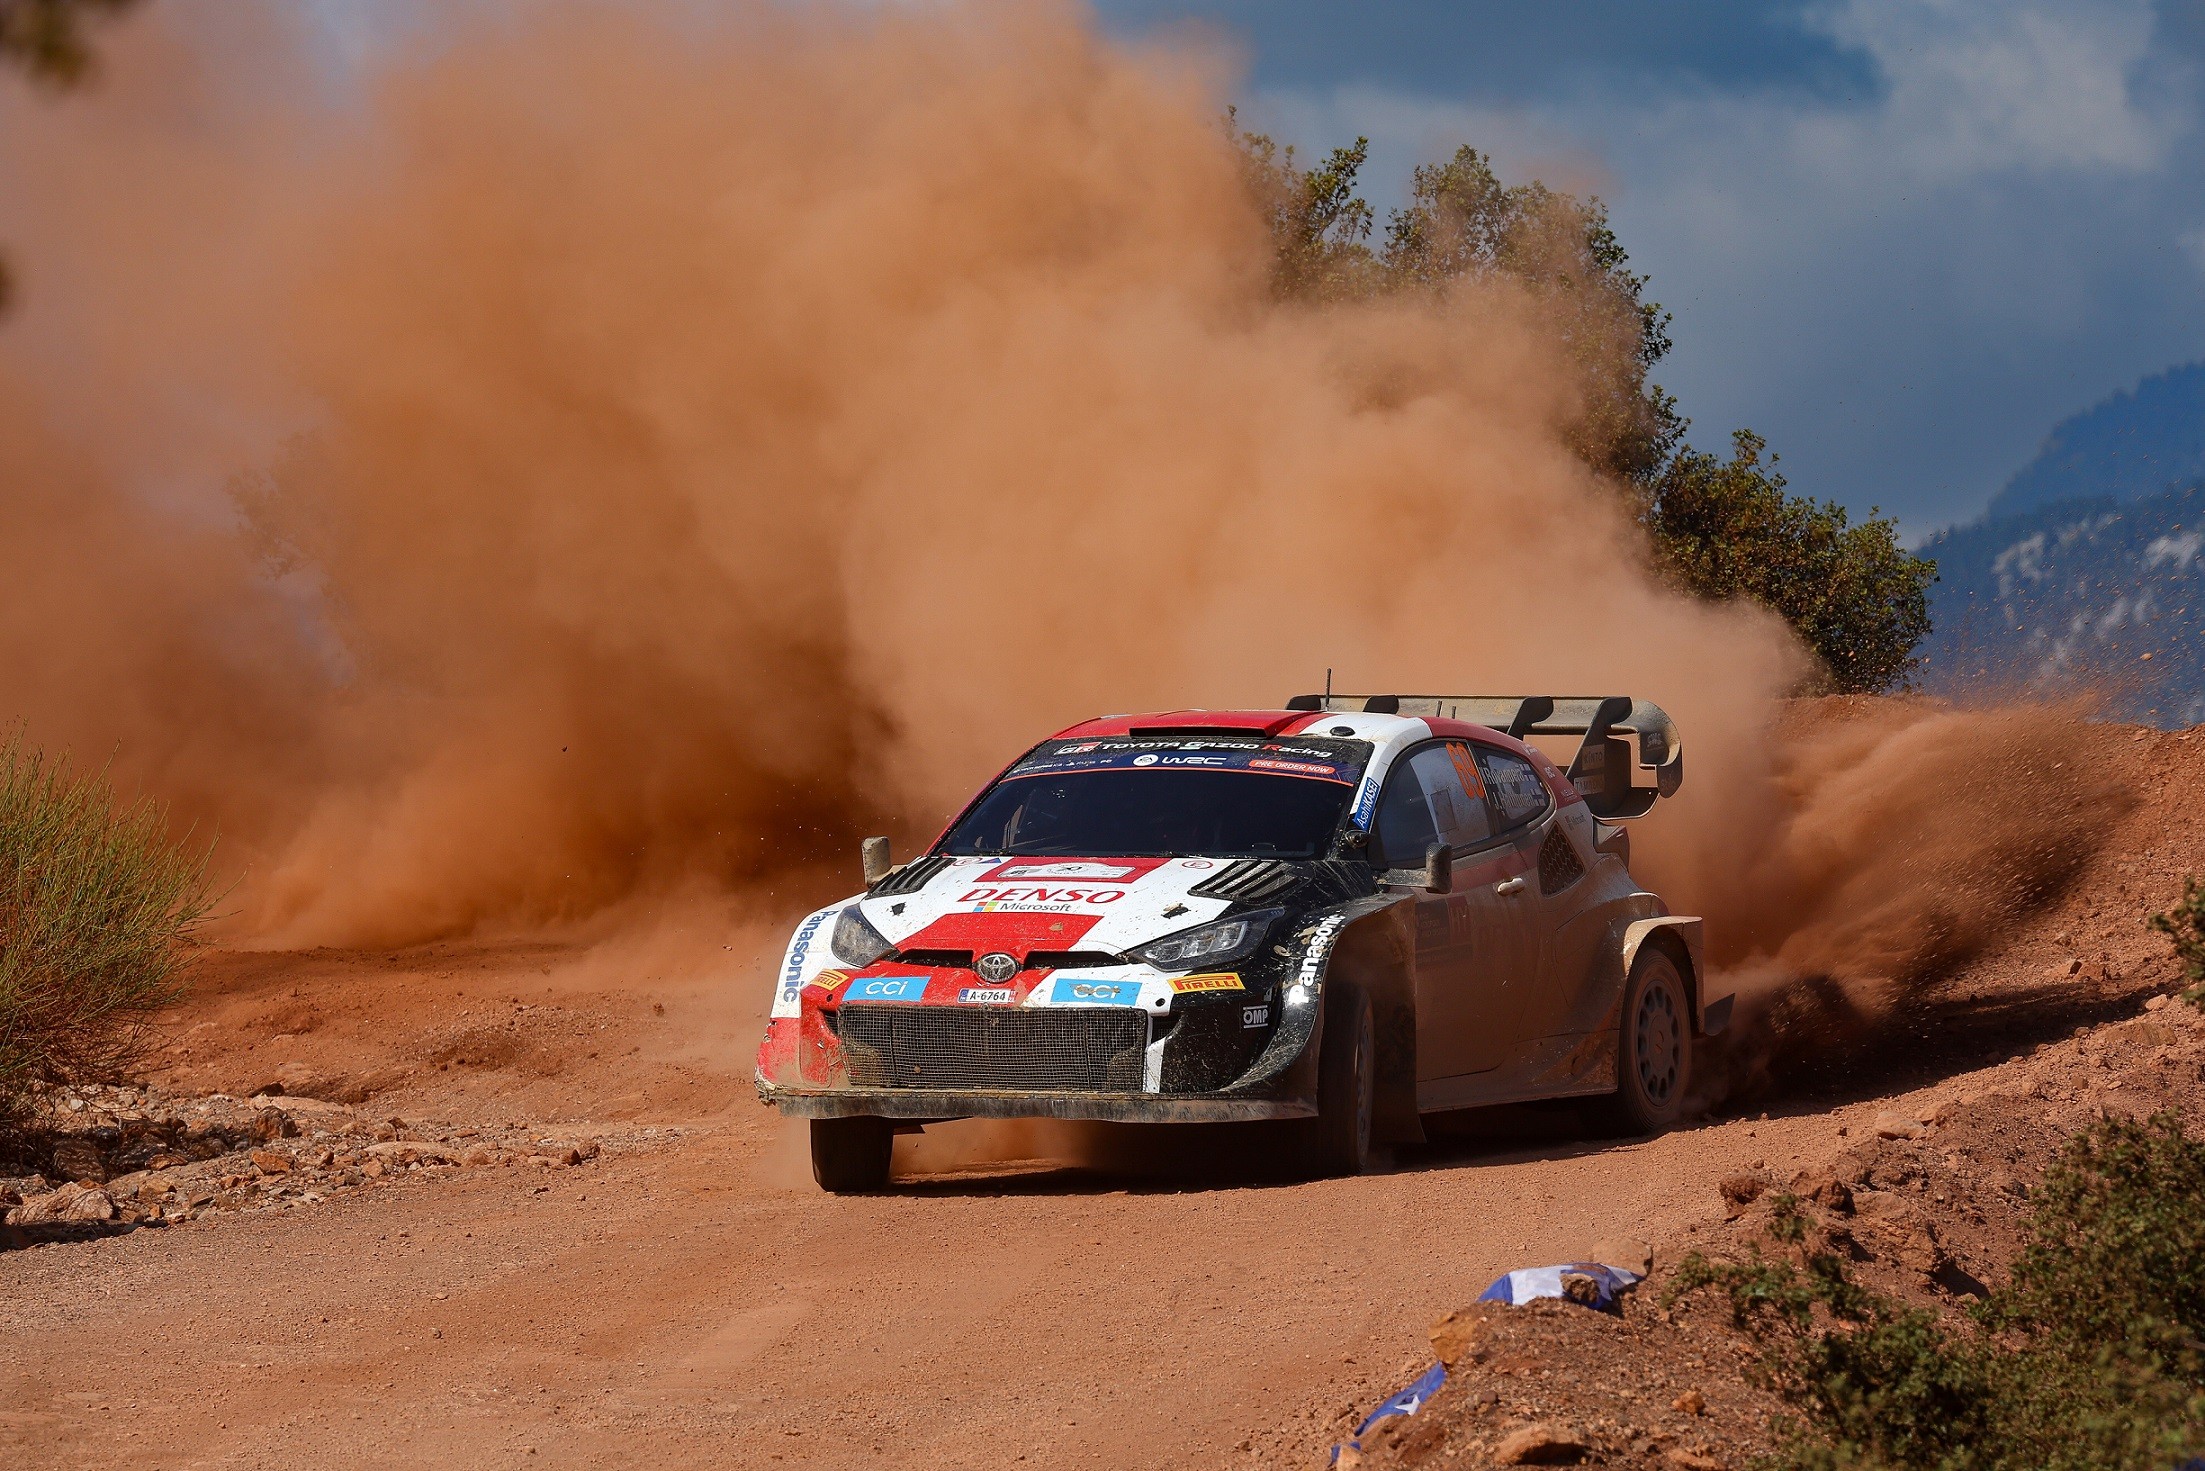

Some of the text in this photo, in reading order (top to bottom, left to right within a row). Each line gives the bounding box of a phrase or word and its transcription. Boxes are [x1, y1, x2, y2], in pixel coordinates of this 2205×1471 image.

[1101, 742, 1180, 751] TOYOTA
[1178, 741, 1260, 751] GAZOO
[1262, 743, 1333, 758] Racing
[1254, 760, 1330, 773] PRE ORDER NOW
[1446, 741, 1485, 800] 69
[956, 888, 1126, 904] DENSO
[1000, 902, 1072, 912] Microsoft
[783, 910, 839, 1003] Panasonic
[1289, 914, 1346, 1004] Panasonic
[1176, 974, 1239, 991] PIRELLI
[969, 991, 1007, 1001] A-6764
[1242, 1009, 1269, 1025] OMP
